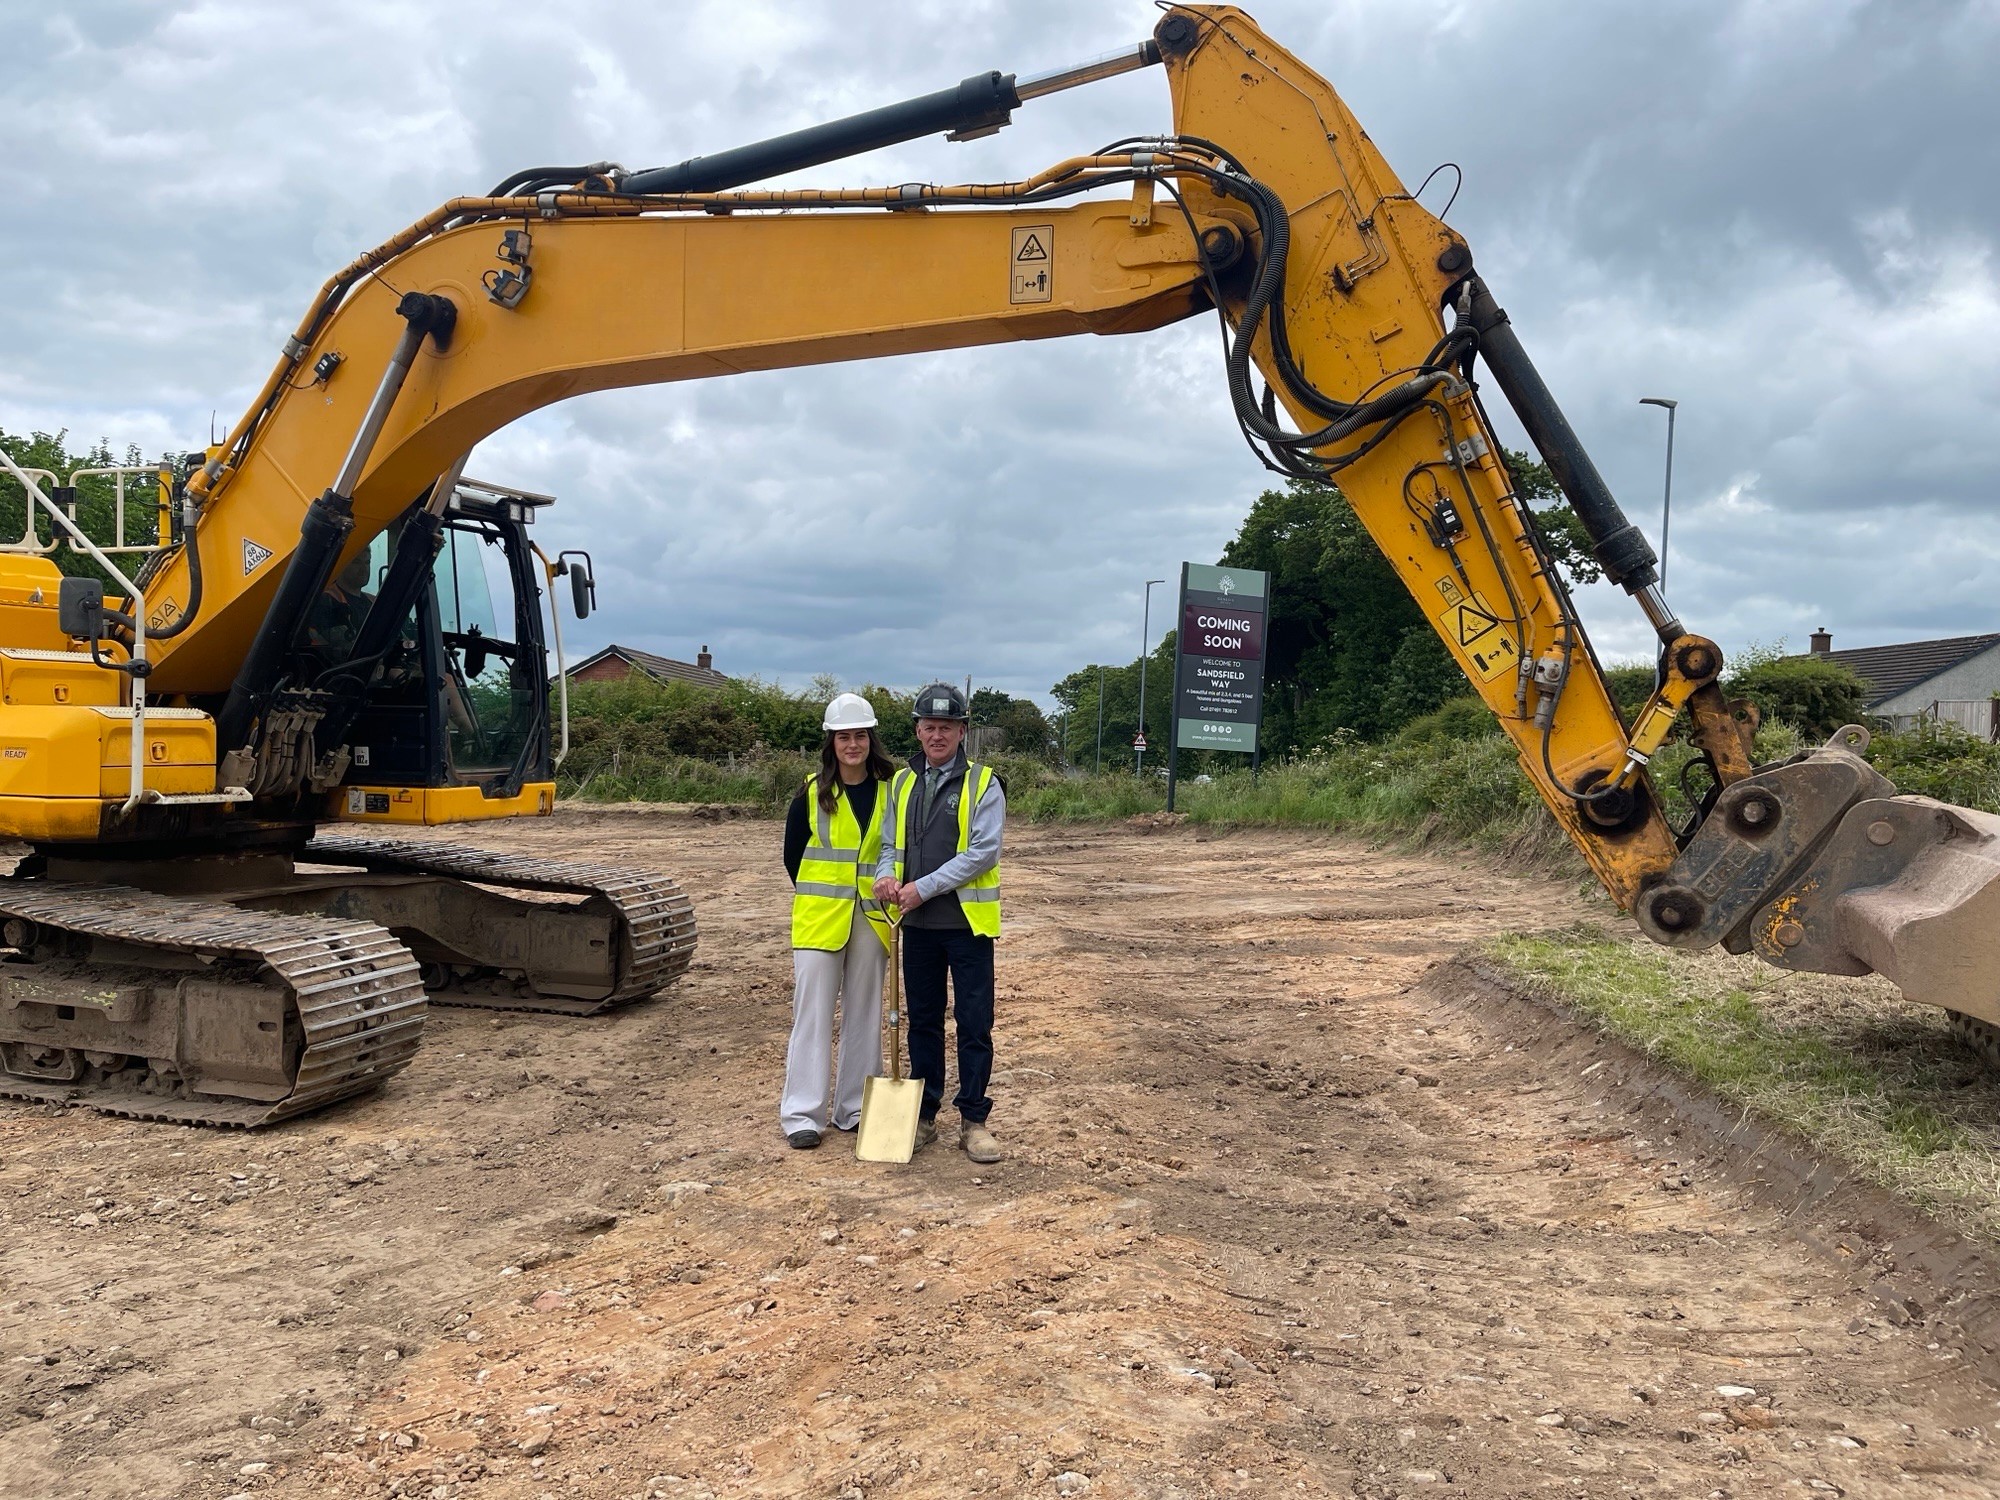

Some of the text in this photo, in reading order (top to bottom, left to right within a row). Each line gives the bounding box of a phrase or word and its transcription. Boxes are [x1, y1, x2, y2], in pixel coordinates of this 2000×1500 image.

[1197, 615, 1251, 633] COMING
[1203, 635, 1242, 650] SOON
[1203, 659, 1231, 667] WELCOME
[1197, 668, 1245, 680] SANDSFIELD
[1211, 679, 1230, 689] WAY
